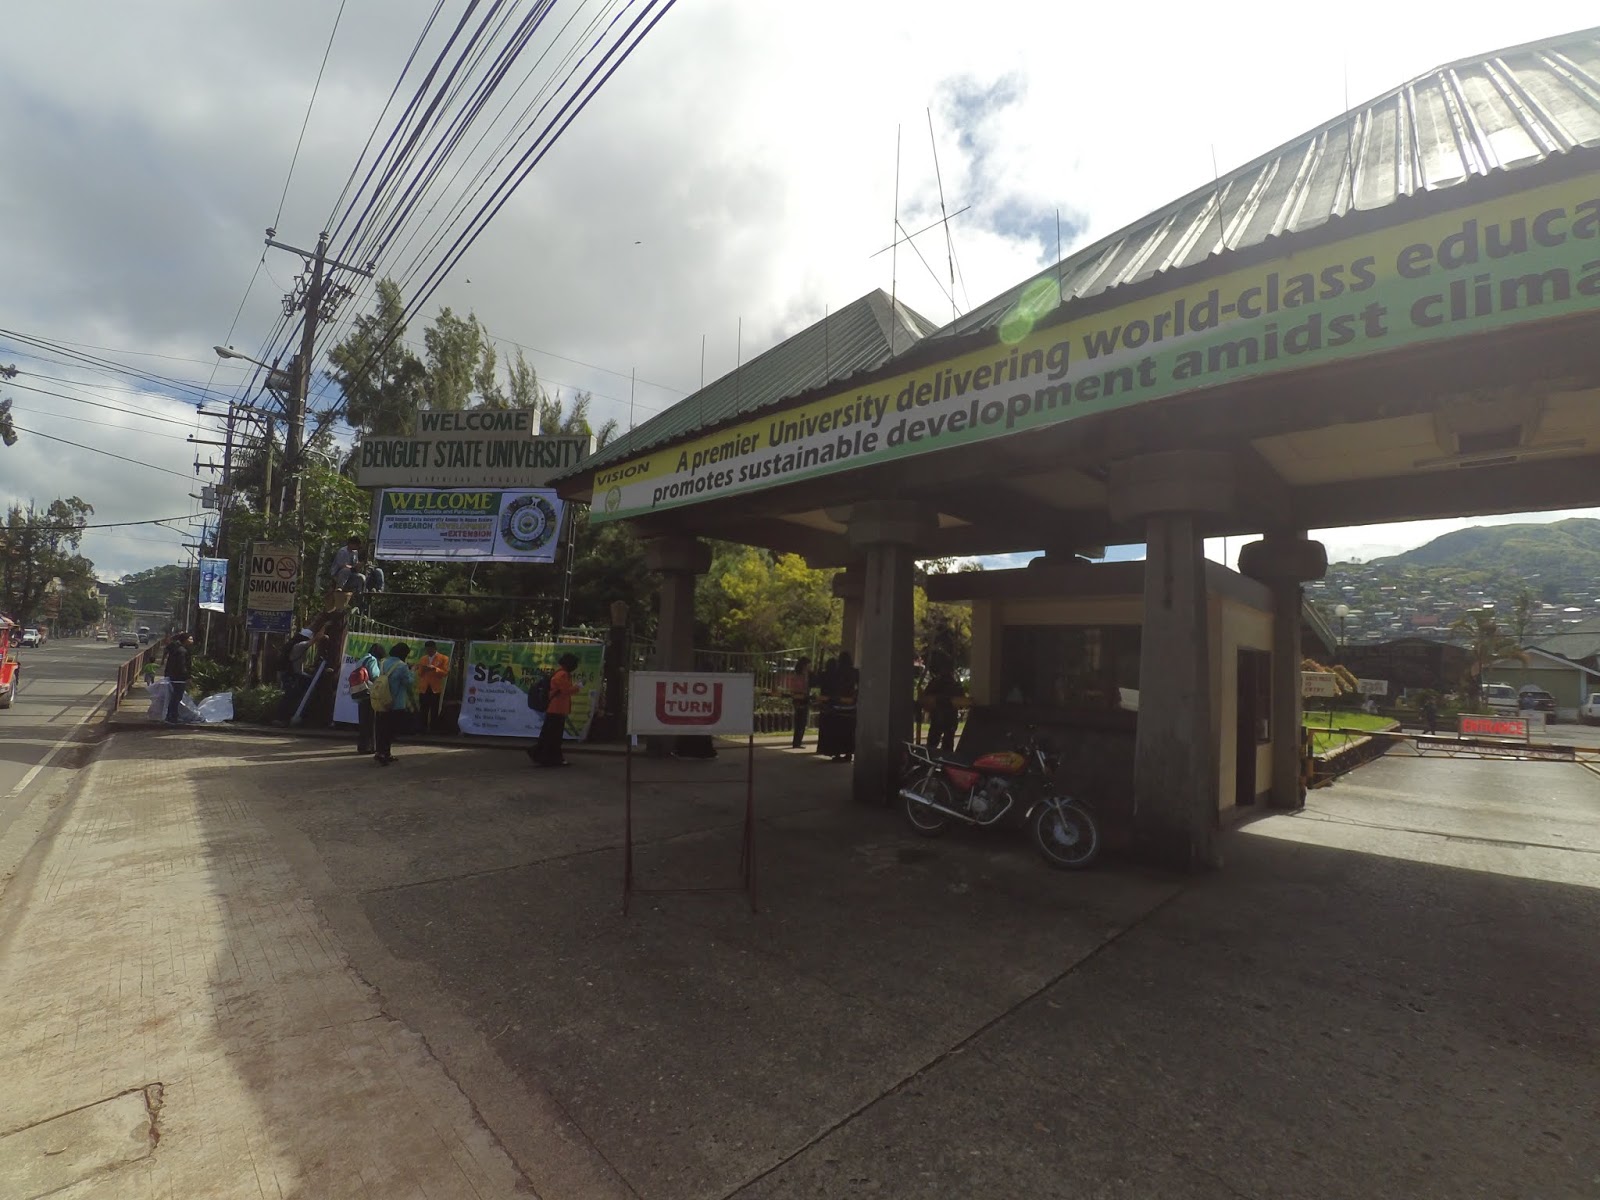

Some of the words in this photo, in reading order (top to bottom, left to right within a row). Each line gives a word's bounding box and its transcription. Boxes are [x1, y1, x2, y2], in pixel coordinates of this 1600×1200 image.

[676, 451, 688, 473] A
[691, 431, 760, 476] premier
[769, 393, 890, 448] University
[895, 340, 1070, 412] delivering
[1083, 255, 1376, 360] world-class
[1396, 198, 1600, 280] educa
[652, 468, 733, 508] promotes
[738, 429, 879, 483] sustainable
[886, 357, 1157, 448] development
[1172, 301, 1389, 381] amidst
[1410, 260, 1600, 328] clima
[420, 412, 530, 432] WELCOME
[361, 440, 432, 468] BENGUET
[433, 439, 484, 468] STATE
[486, 439, 587, 468] UNIVERSITY
[596, 461, 649, 486] VISION
[389, 492, 493, 509] WELCOME
[448, 530, 492, 538] EXTENSION
[252, 556, 275, 575] NO
[249, 579, 296, 594] SMOKING
[473, 662, 516, 685] SEA
[672, 681, 708, 696] NO
[665, 700, 713, 713] TURN
[1462, 717, 1525, 735] ENTRANCE
